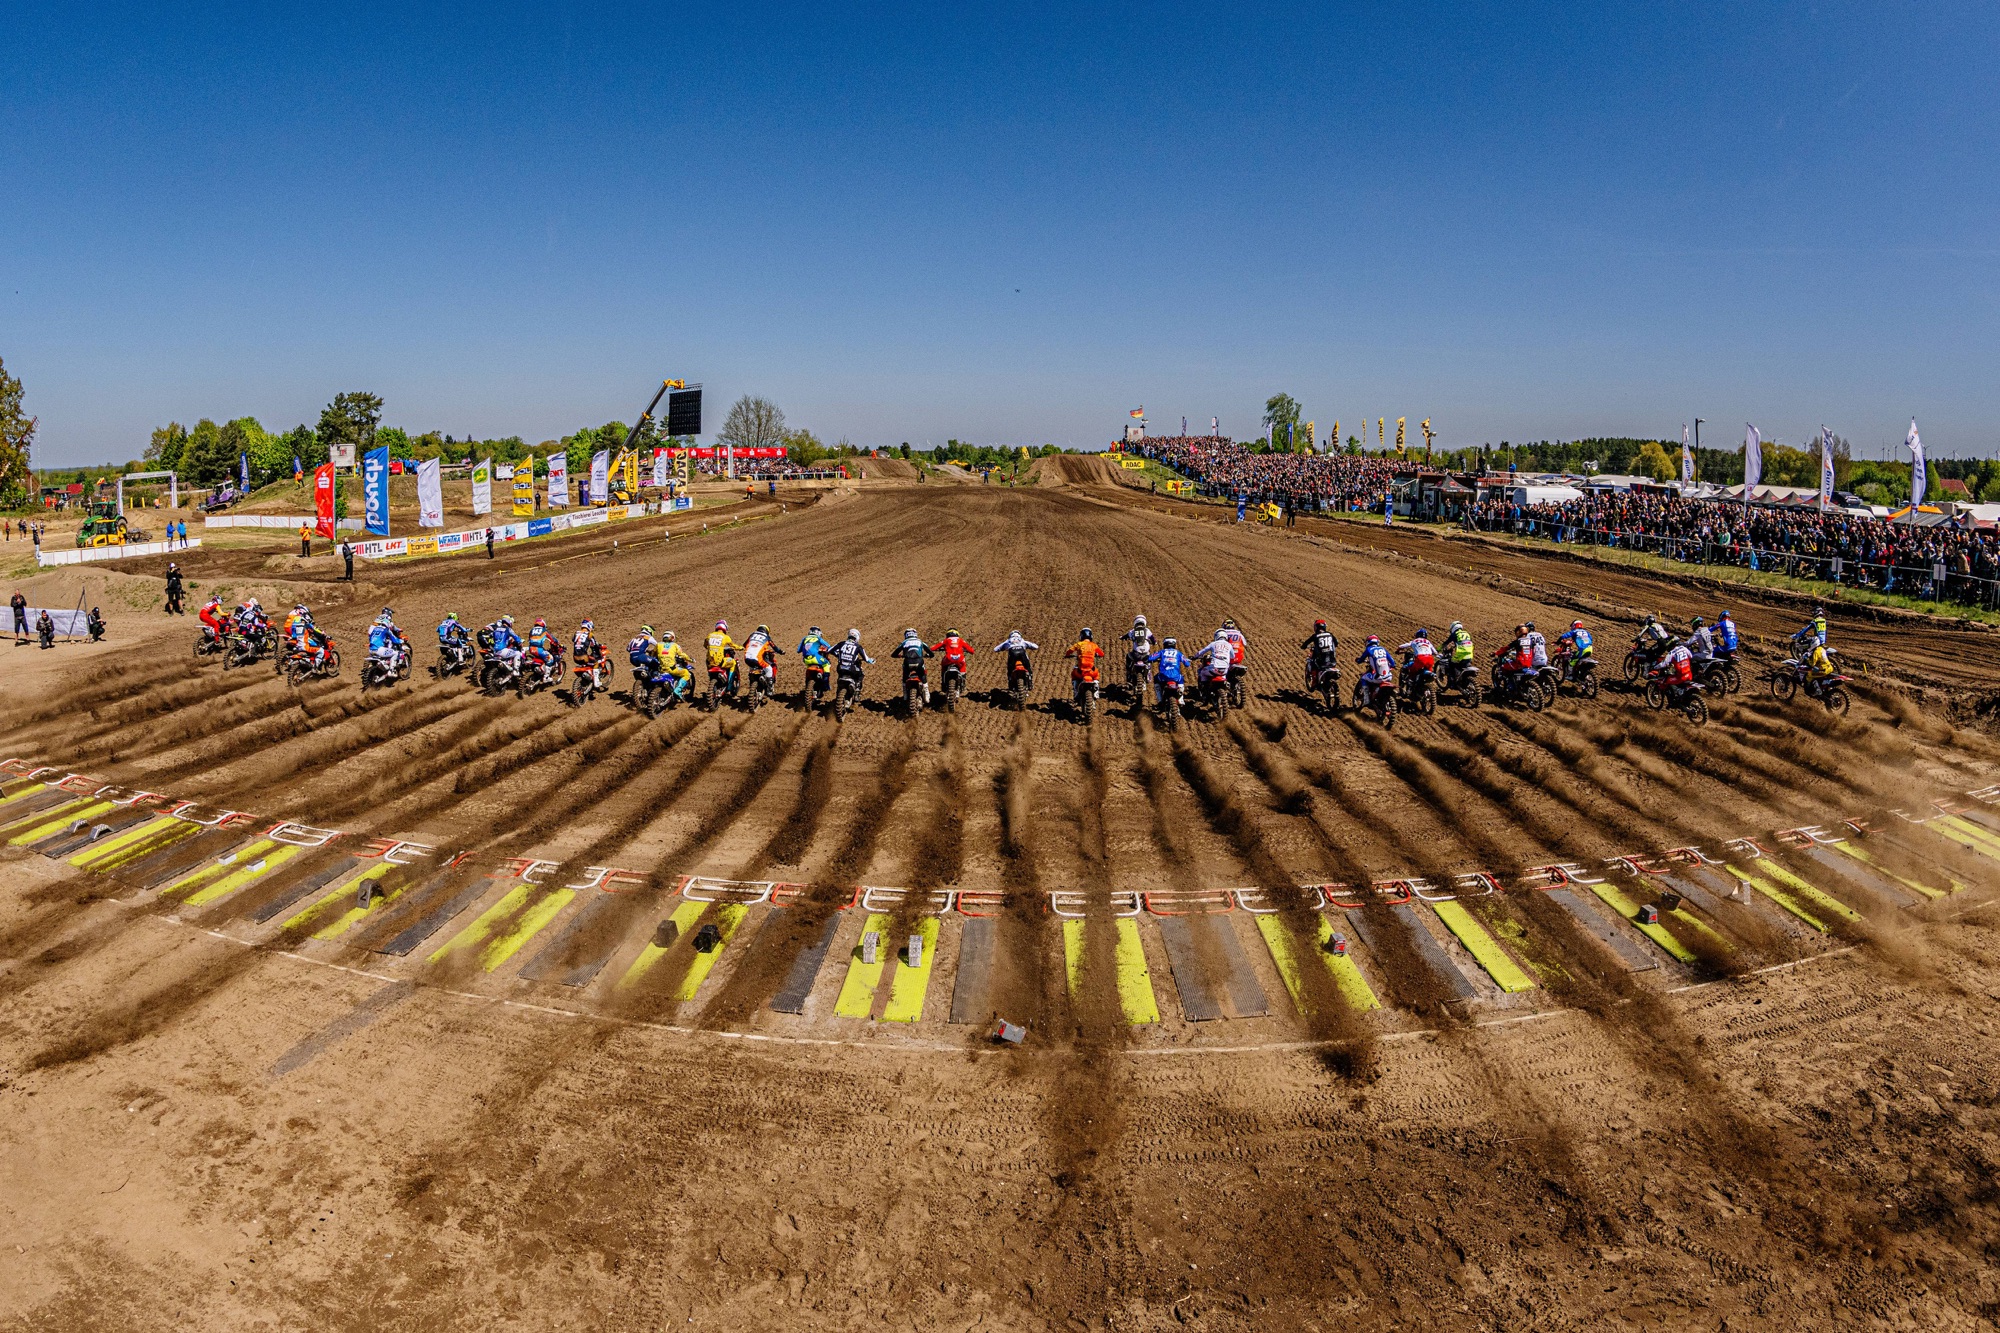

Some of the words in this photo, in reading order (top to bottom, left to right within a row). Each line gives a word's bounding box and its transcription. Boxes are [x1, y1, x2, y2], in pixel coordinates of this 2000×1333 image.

[549, 469, 564, 478] EWT
[365, 542, 383, 554] HTL
[386, 541, 402, 550] LKT
[841, 644, 857, 655] 431
